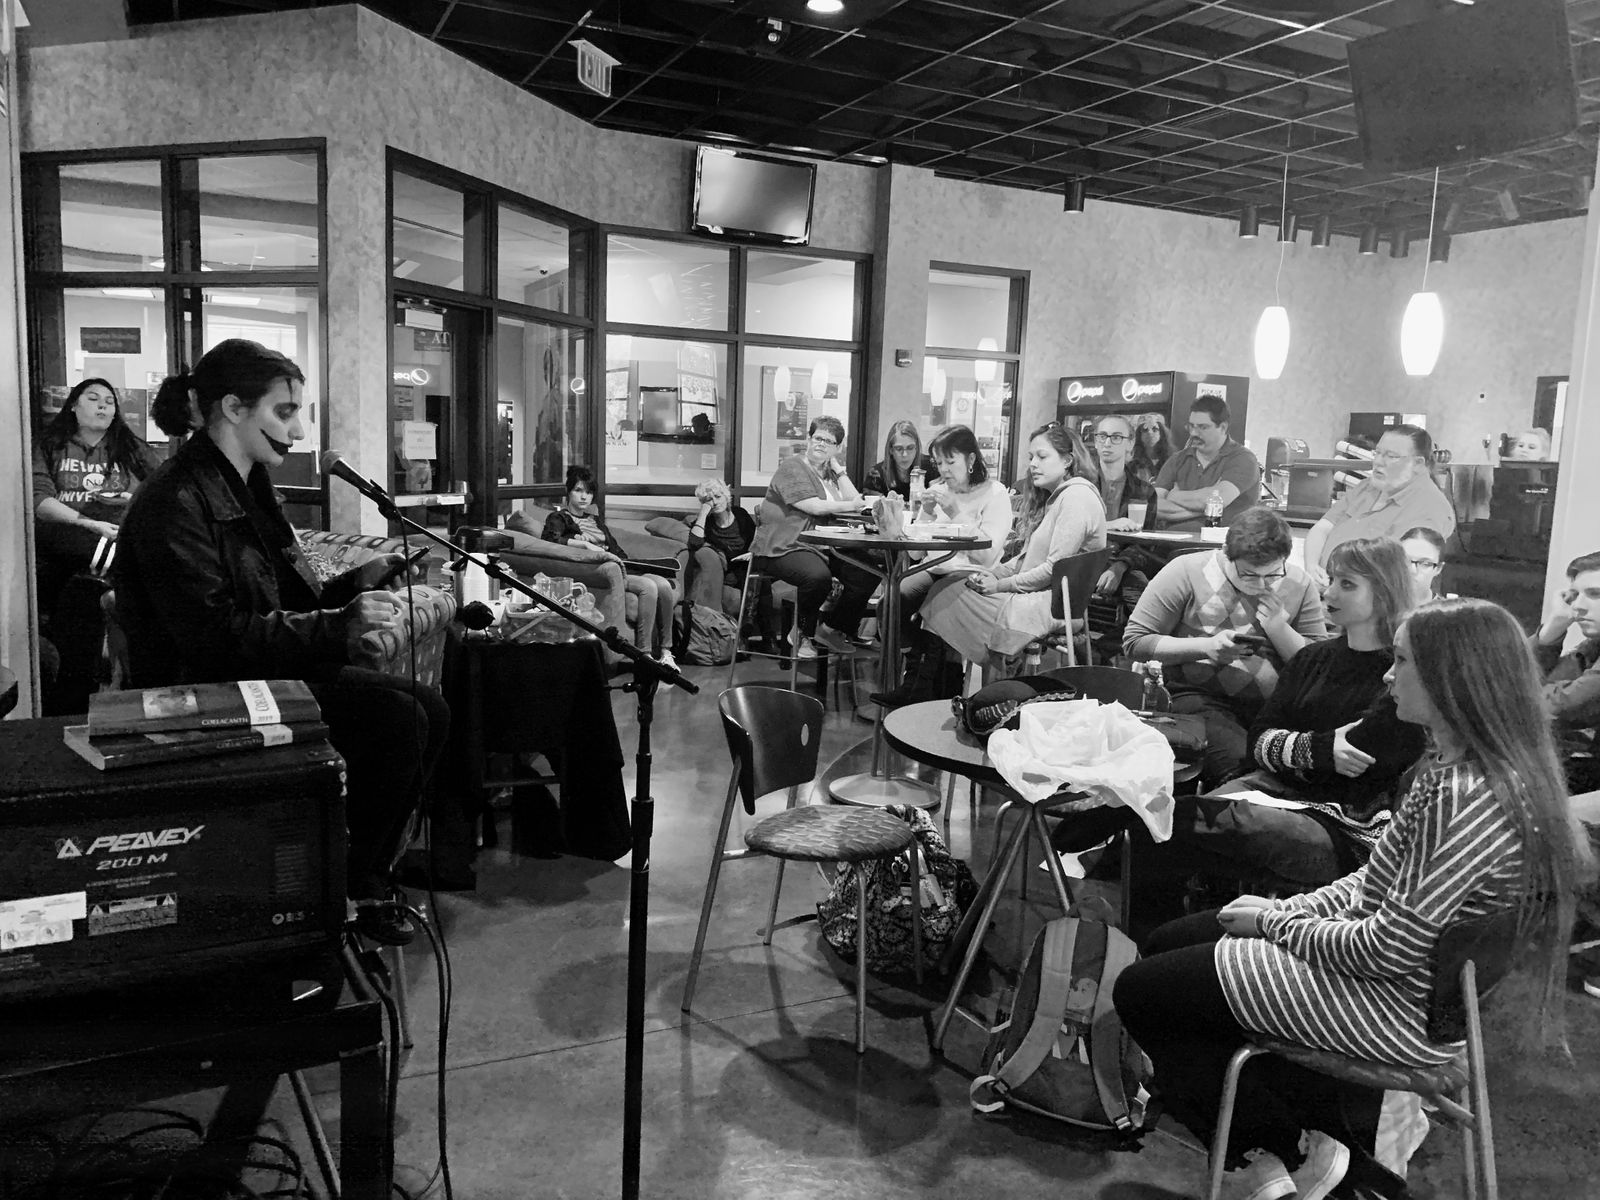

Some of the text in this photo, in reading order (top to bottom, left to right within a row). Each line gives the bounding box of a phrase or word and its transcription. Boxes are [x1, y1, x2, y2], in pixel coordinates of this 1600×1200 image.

[584, 54, 608, 92] EXIT
[1081, 385, 1104, 398] pepsi
[1138, 382, 1163, 396] pepsi
[86, 825, 205, 855] PEAVEY
[96, 852, 169, 870] 200 M
